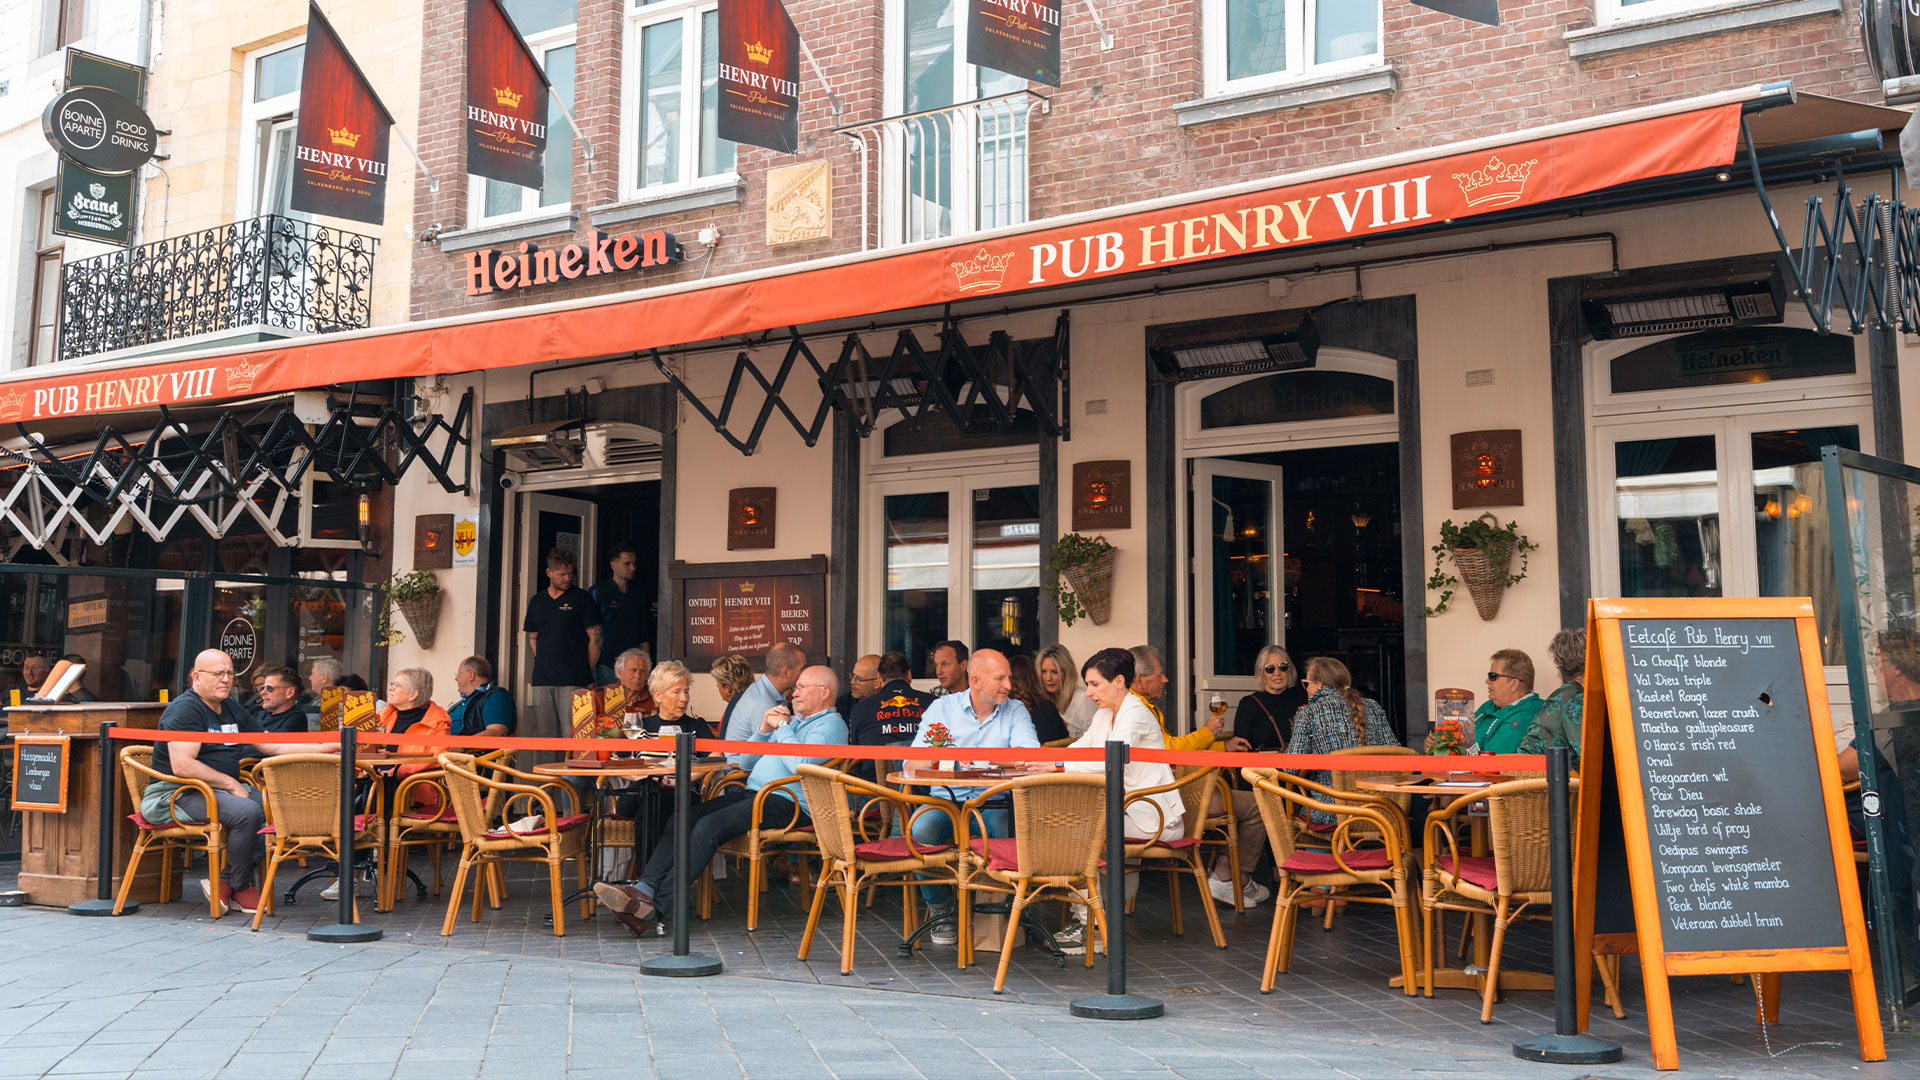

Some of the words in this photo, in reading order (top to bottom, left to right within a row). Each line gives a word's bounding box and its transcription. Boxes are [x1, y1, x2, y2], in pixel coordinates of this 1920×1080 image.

[1032, 1, 1060, 27] VIII
[1006, 15, 1027, 31] Pub
[719, 62, 769, 90] HENRY
[771, 76, 798, 98] VIII
[747, 90, 768, 104] Pub
[64, 109, 103, 129] BONNE
[467, 105, 518, 131] HENRY
[520, 119, 546, 139] VIII
[64, 121, 102, 140] APARTE
[115, 120, 147, 136] FOOD
[111, 134, 149, 153] DRINKS
[496, 131, 517, 144] Pub
[296, 145, 355, 170] HENRY
[356, 157, 387, 177] VIII
[328, 169, 351, 182] Pub
[73, 192, 119, 216] Brand
[1027, 231, 1125, 285] PUB
[1137, 196, 1322, 267] HENRY
[1326, 174, 1432, 234] VIII
[463, 230, 672, 297] Heineken
[1680, 347, 1783, 371] Heineken
[32, 385, 79, 418] PUB
[83, 373, 168, 412] HENRY
[169, 367, 217, 401] VIII
[688, 598, 717, 608] ONTBIJT
[724, 597, 754, 606] HENRY
[755, 596, 771, 606] VIII
[789, 594, 800, 605] 12
[691, 617, 715, 626] LUNCH
[781, 609, 809, 618] BIEREN
[781, 623, 797, 632] VAN
[797, 623, 810, 632] DE
[223, 634, 253, 646] BONNE
[692, 635, 715, 645] DINER
[788, 636, 803, 646] TAP
[1627, 624, 1677, 652] Eetcafé
[1683, 625, 1708, 645] Pub
[1714, 627, 1749, 655] Henry
[1631, 653, 1648, 667] La
[1651, 654, 1689, 672] Chouffe
[1694, 654, 1728, 668] blonde
[1633, 673, 1651, 686] Val
[1654, 673, 1680, 686] Dieu
[1684, 673, 1712, 689] triple
[1636, 689, 1674, 703] Kasteel
[1678, 688, 1708, 706] Rouge
[876, 708, 900, 721] Red
[1638, 706, 1699, 719] Beavertown
[1702, 705, 1728, 719] lazer
[1731, 705, 1760, 719] crush
[882, 723, 913, 735] Mobil
[1641, 721, 1679, 734] Martha
[1691, 738, 1715, 751] irish
[1718, 738, 1737, 750] red
[1646, 754, 1674, 768] Orval
[1648, 769, 1709, 790] Hoegaarden
[1712, 767, 1729, 782] wit
[1650, 786, 1674, 801] Paix
[1678, 787, 1704, 801] Dieu
[1651, 804, 1699, 823] Brewdog
[1701, 804, 1730, 817] basic
[1734, 802, 1763, 816] shake
[1654, 823, 1682, 842] Uiltje
[1685, 823, 1709, 836] bird
[1712, 821, 1723, 840] of
[1659, 844, 1699, 860] Oedipus
[1704, 843, 1749, 860] swingers
[1660, 861, 1708, 879] Kompaan
[1711, 857, 1783, 880] levensgenieter
[1662, 879, 1685, 893] Two
[1689, 877, 1716, 897] chefs
[1721, 877, 1750, 891] white
[1754, 876, 1790, 889] mamba
[1667, 895, 1693, 912] Peak
[1697, 895, 1733, 911] blonde
[1671, 915, 1718, 931] Veteraan
[1721, 912, 1752, 929] dubbel
[1754, 911, 1784, 927] bruin
